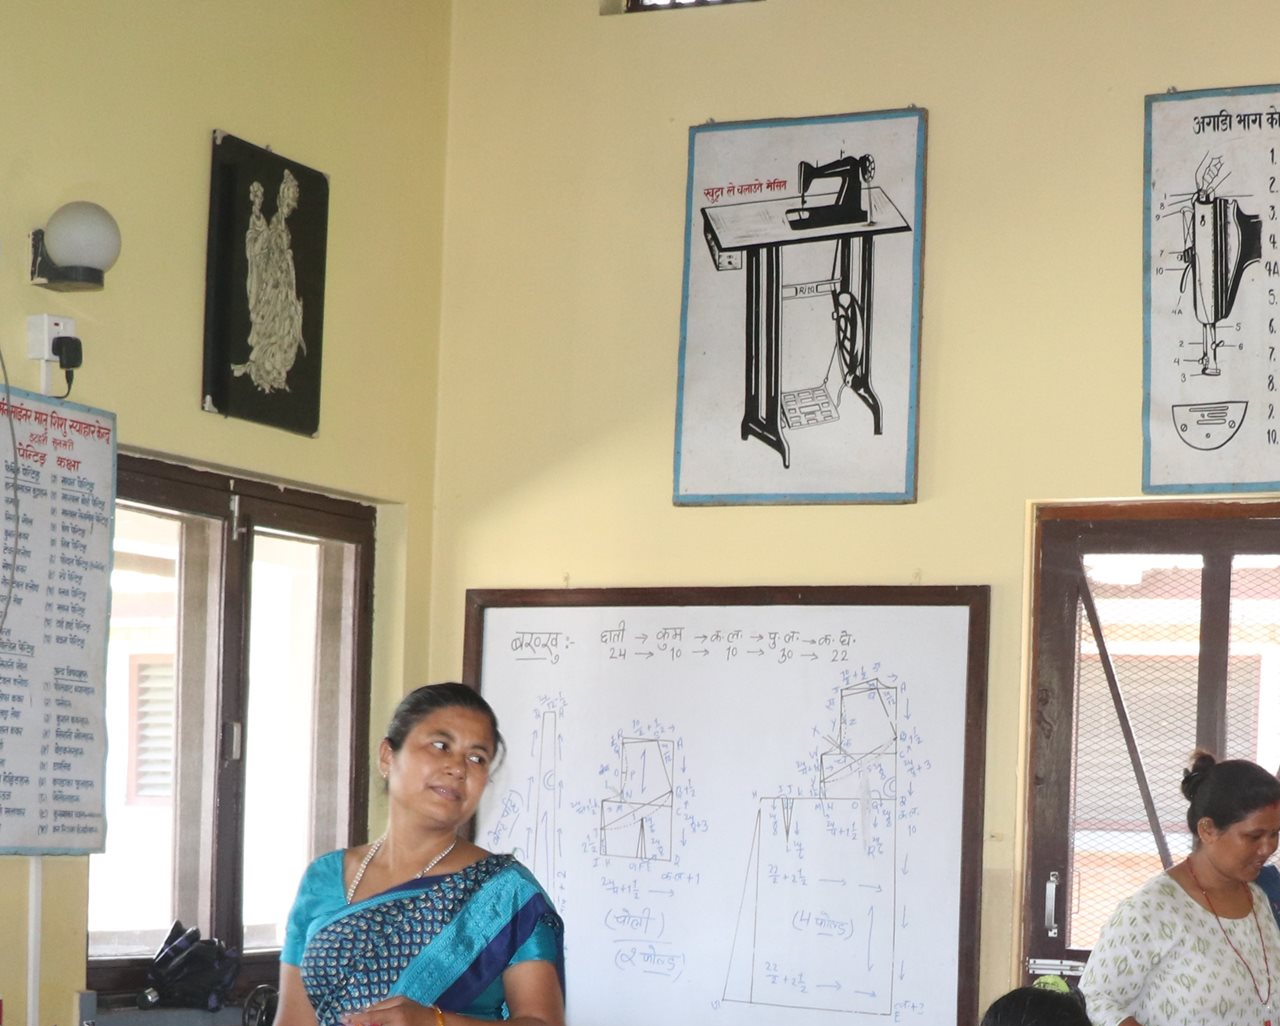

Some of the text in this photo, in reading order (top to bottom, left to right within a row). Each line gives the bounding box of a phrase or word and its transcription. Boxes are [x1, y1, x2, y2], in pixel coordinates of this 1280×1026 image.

[1236, 113, 1263, 131] भाग
[56, 456, 81, 472] कक्षा
[609, 648, 627, 660] 24
[778, 647, 793, 664] 30
[831, 650, 848, 662] 22
